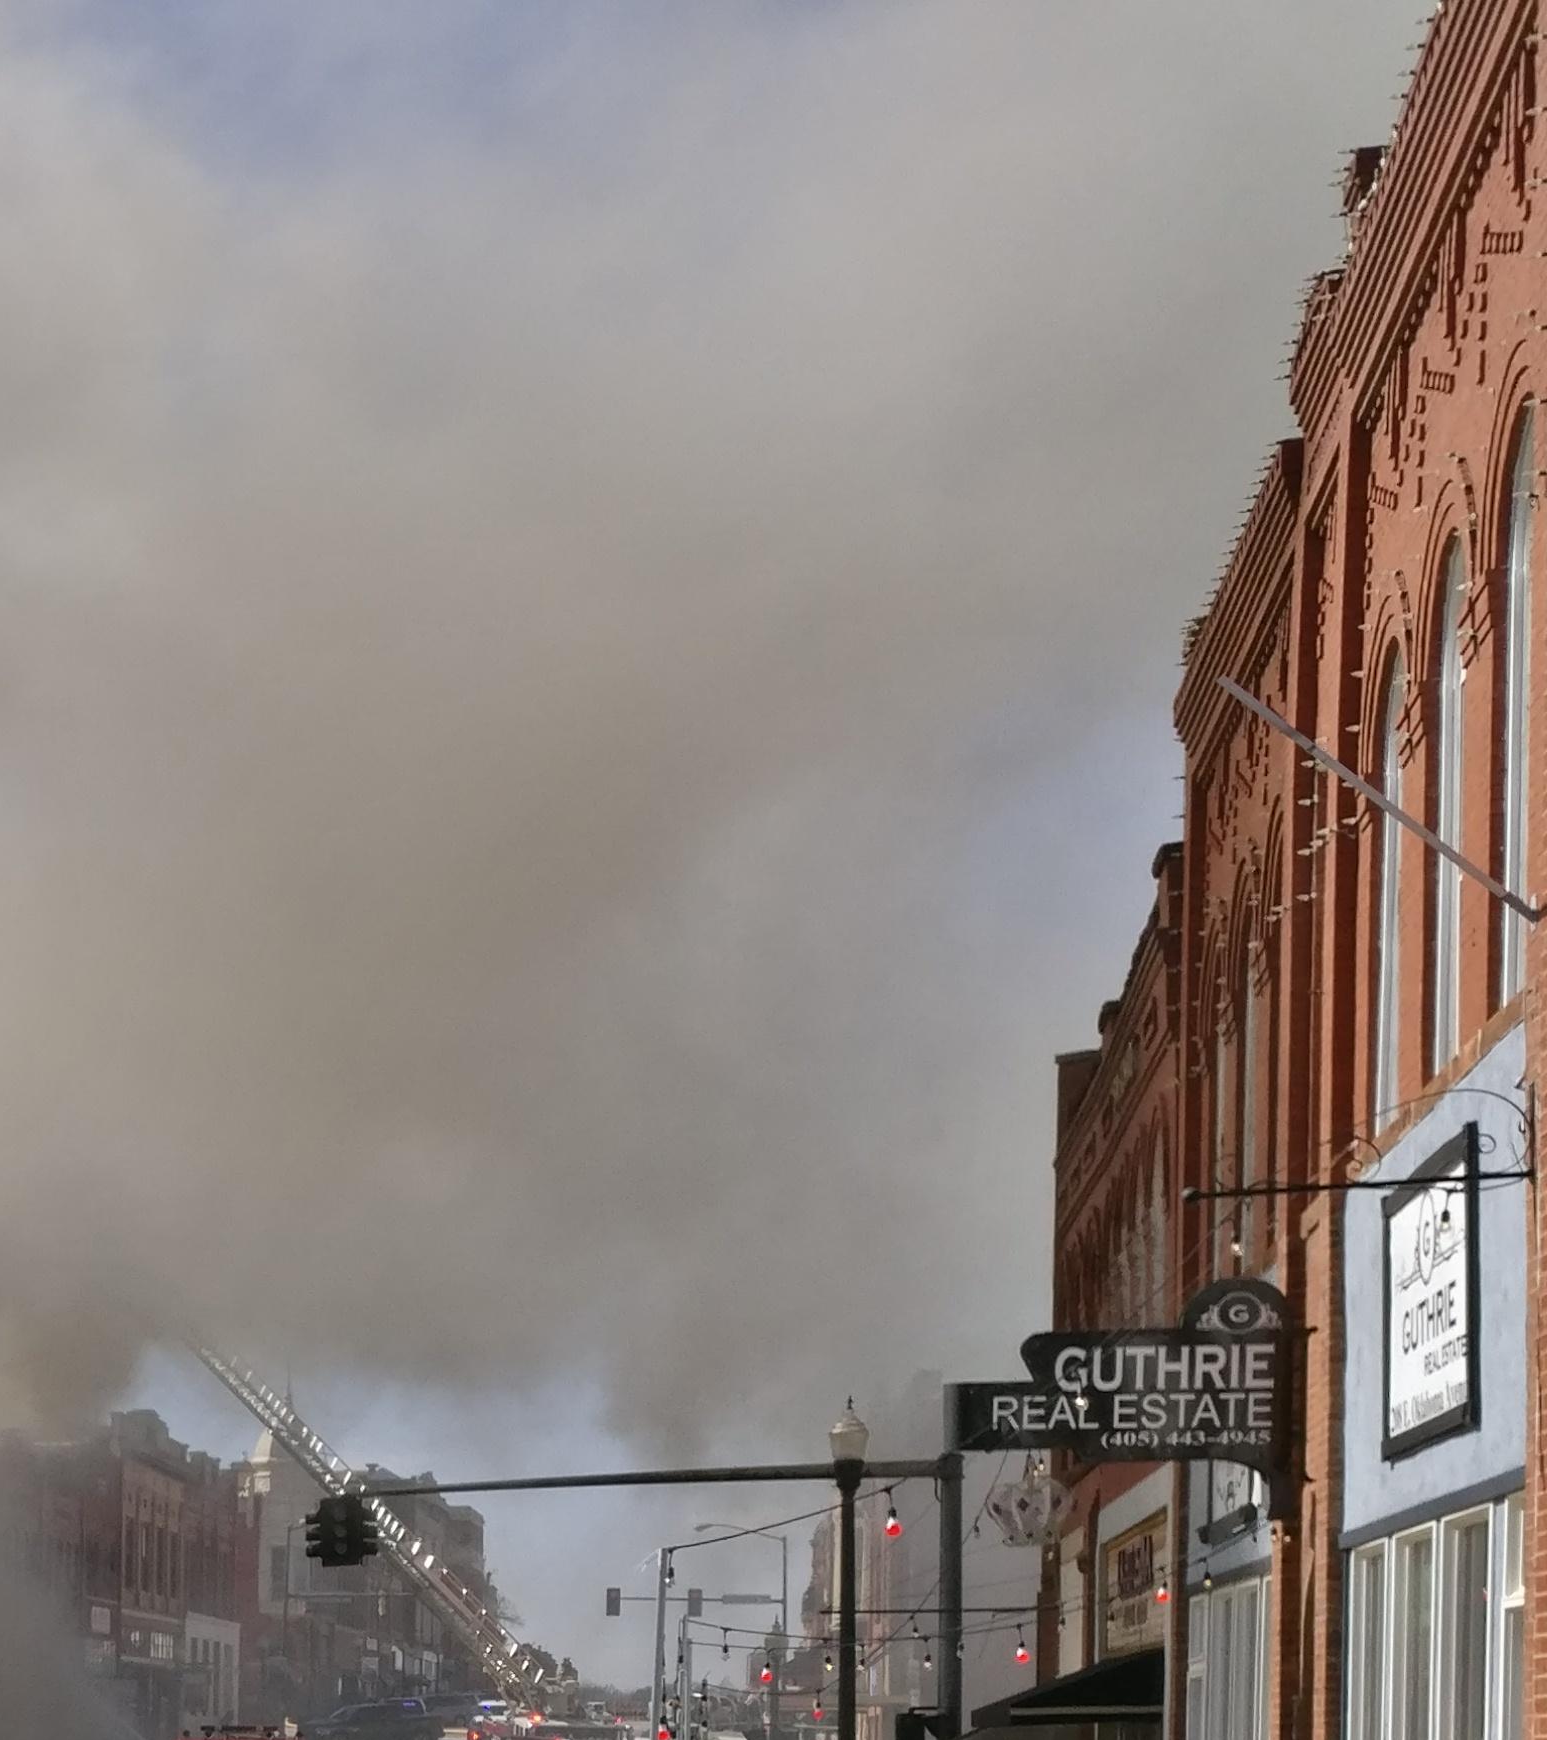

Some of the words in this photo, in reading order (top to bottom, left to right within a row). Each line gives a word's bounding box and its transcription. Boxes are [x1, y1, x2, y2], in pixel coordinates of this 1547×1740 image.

[1402, 1280, 1456, 1355] GUTHRIE
[1054, 1343, 1276, 1393] GUTHRIE
[992, 1395, 1100, 1431] REAL
[1113, 1392, 1274, 1429] ESTATE
[1100, 1431, 1158, 1449] (405)
[1165, 1429, 1273, 1448] 443-4945
